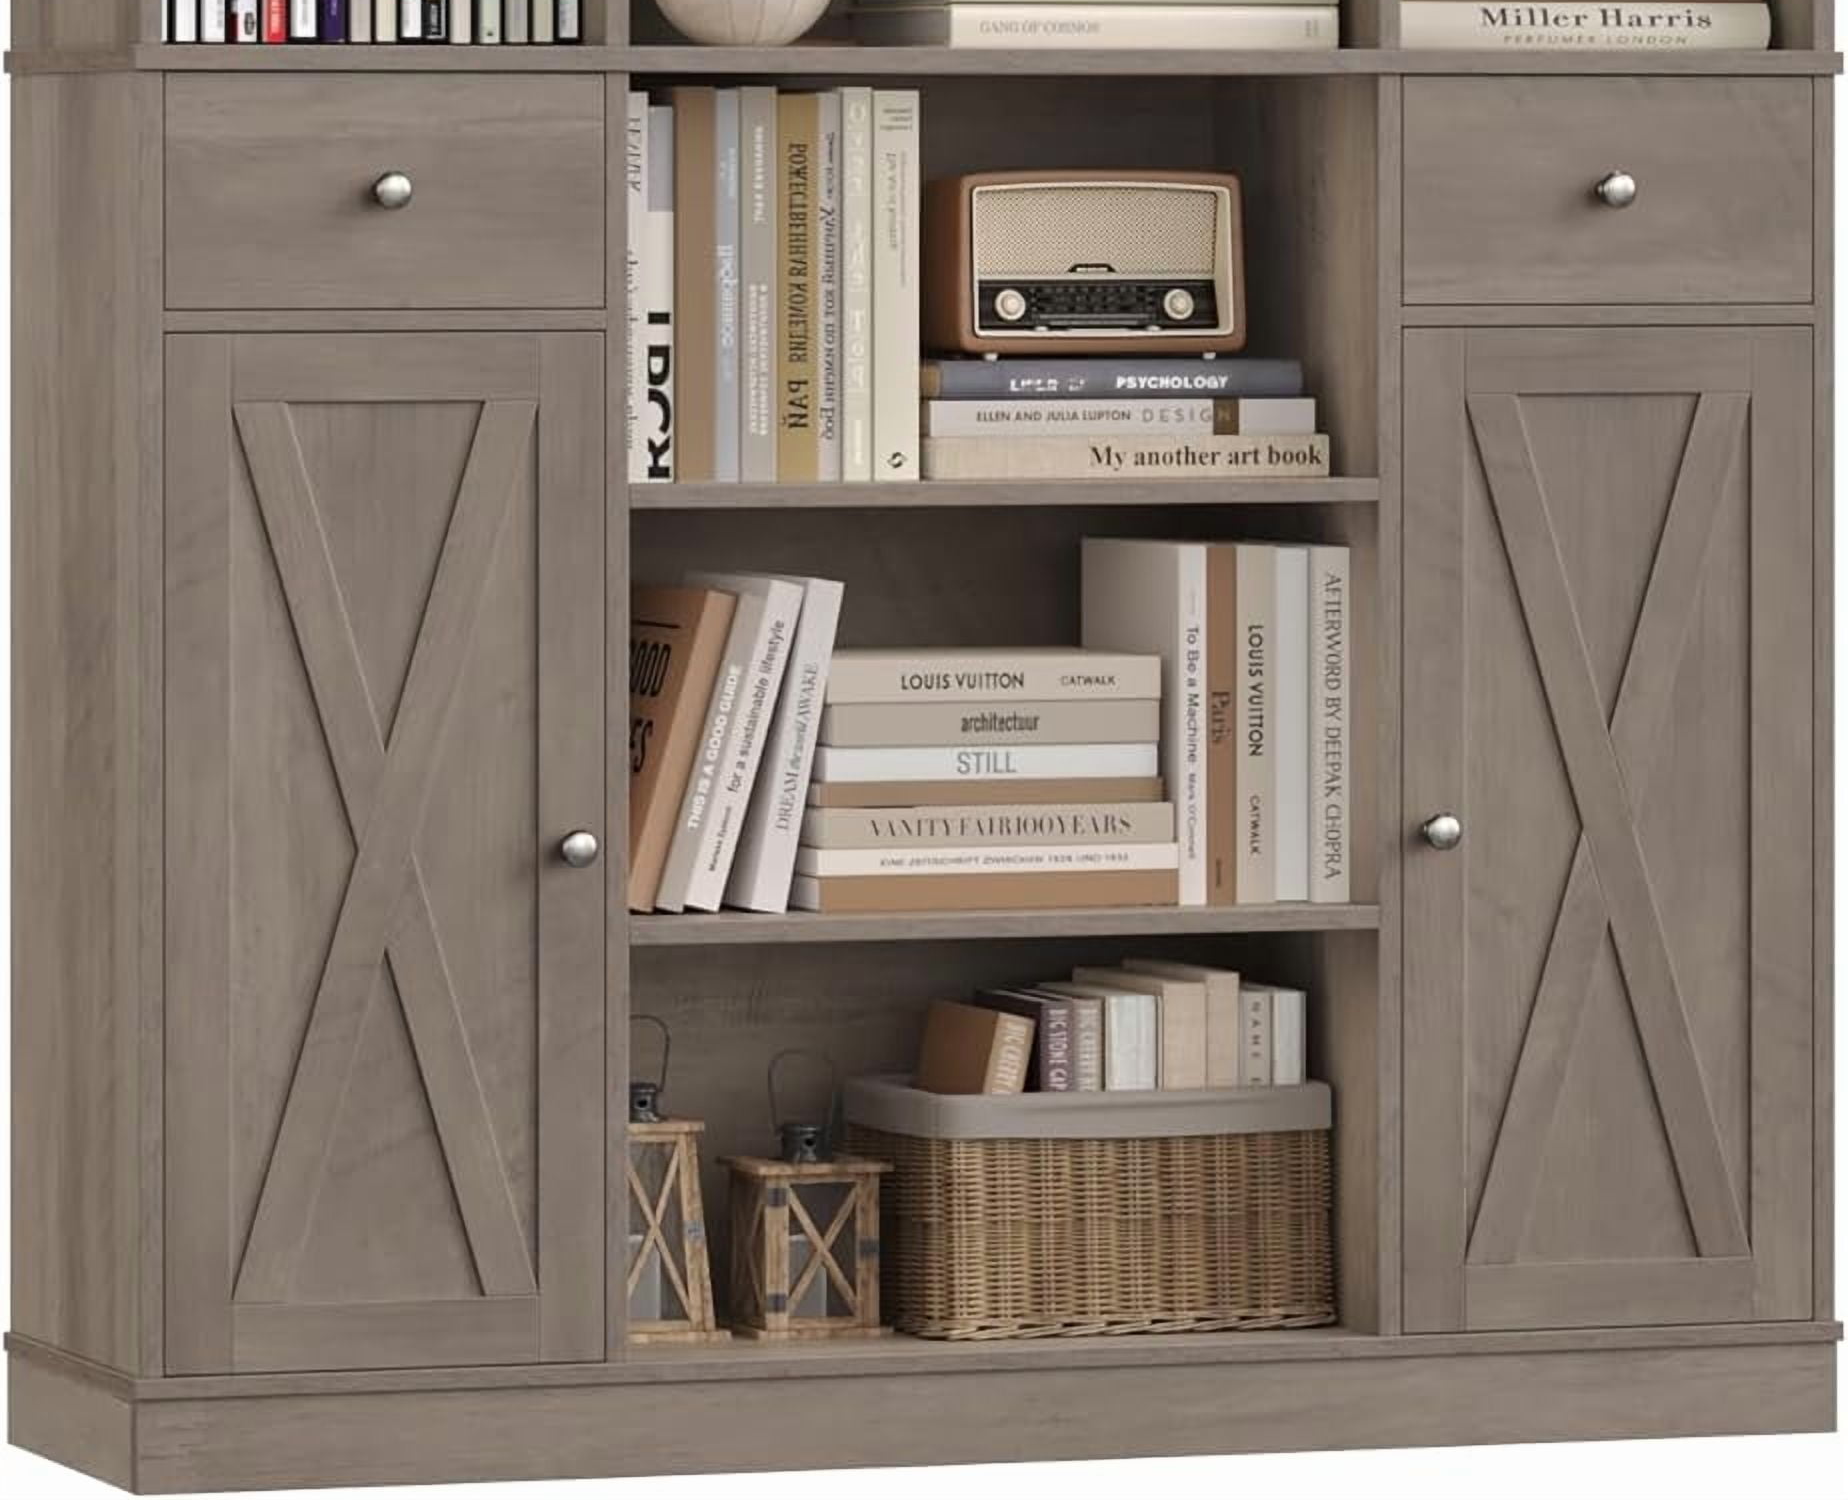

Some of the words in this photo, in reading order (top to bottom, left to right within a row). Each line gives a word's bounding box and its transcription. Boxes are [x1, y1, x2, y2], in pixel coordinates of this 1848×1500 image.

[1480, 6, 1589, 28] Miller
[1600, 7, 1713, 29] Harris
[1606, 35, 1689, 46] LONDON
[1115, 375, 1229, 389] PSYCHOLOGY
[976, 410, 1011, 422] ELLEN
[1014, 410, 1043, 422] AND
[1046, 410, 1080, 422] JULIA
[1082, 409, 1132, 421] LUPTON
[1142, 407, 1232, 423] DESIGN
[1089, 445, 1126, 471] My
[1133, 445, 1221, 467] another
[1227, 447, 1259, 467] art
[1267, 443, 1322, 467] book
[1186, 627, 1199, 645] To
[1323, 572, 1342, 691] AFTERWORD
[1186, 650, 1199, 673] Be
[1247, 624, 1265, 678] LOUIS
[900, 673, 952, 690] LOUIS
[954, 672, 1025, 690] VUITTON
[1060, 675, 1117, 687] CATWALK
[1187, 678, 1198, 688] a
[727, 773, 744, 794] for
[740, 677, 770, 758] sustainable
[760, 619, 785, 674] lifestyle
[1211, 691, 1232, 745] Paris
[1247, 682, 1265, 757] VUITTON
[1324, 696, 1342, 722] BY
[960, 711, 1040, 733] architectuur
[1186, 693, 1200, 763] Machine
[706, 713, 729, 761] GOOD
[955, 751, 1017, 775] STILL
[1324, 726, 1343, 798] DEEPAK
[776, 773, 801, 831] DREAM
[1249, 794, 1262, 855] CATWALK
[1324, 803, 1343, 880] CHOPRA
